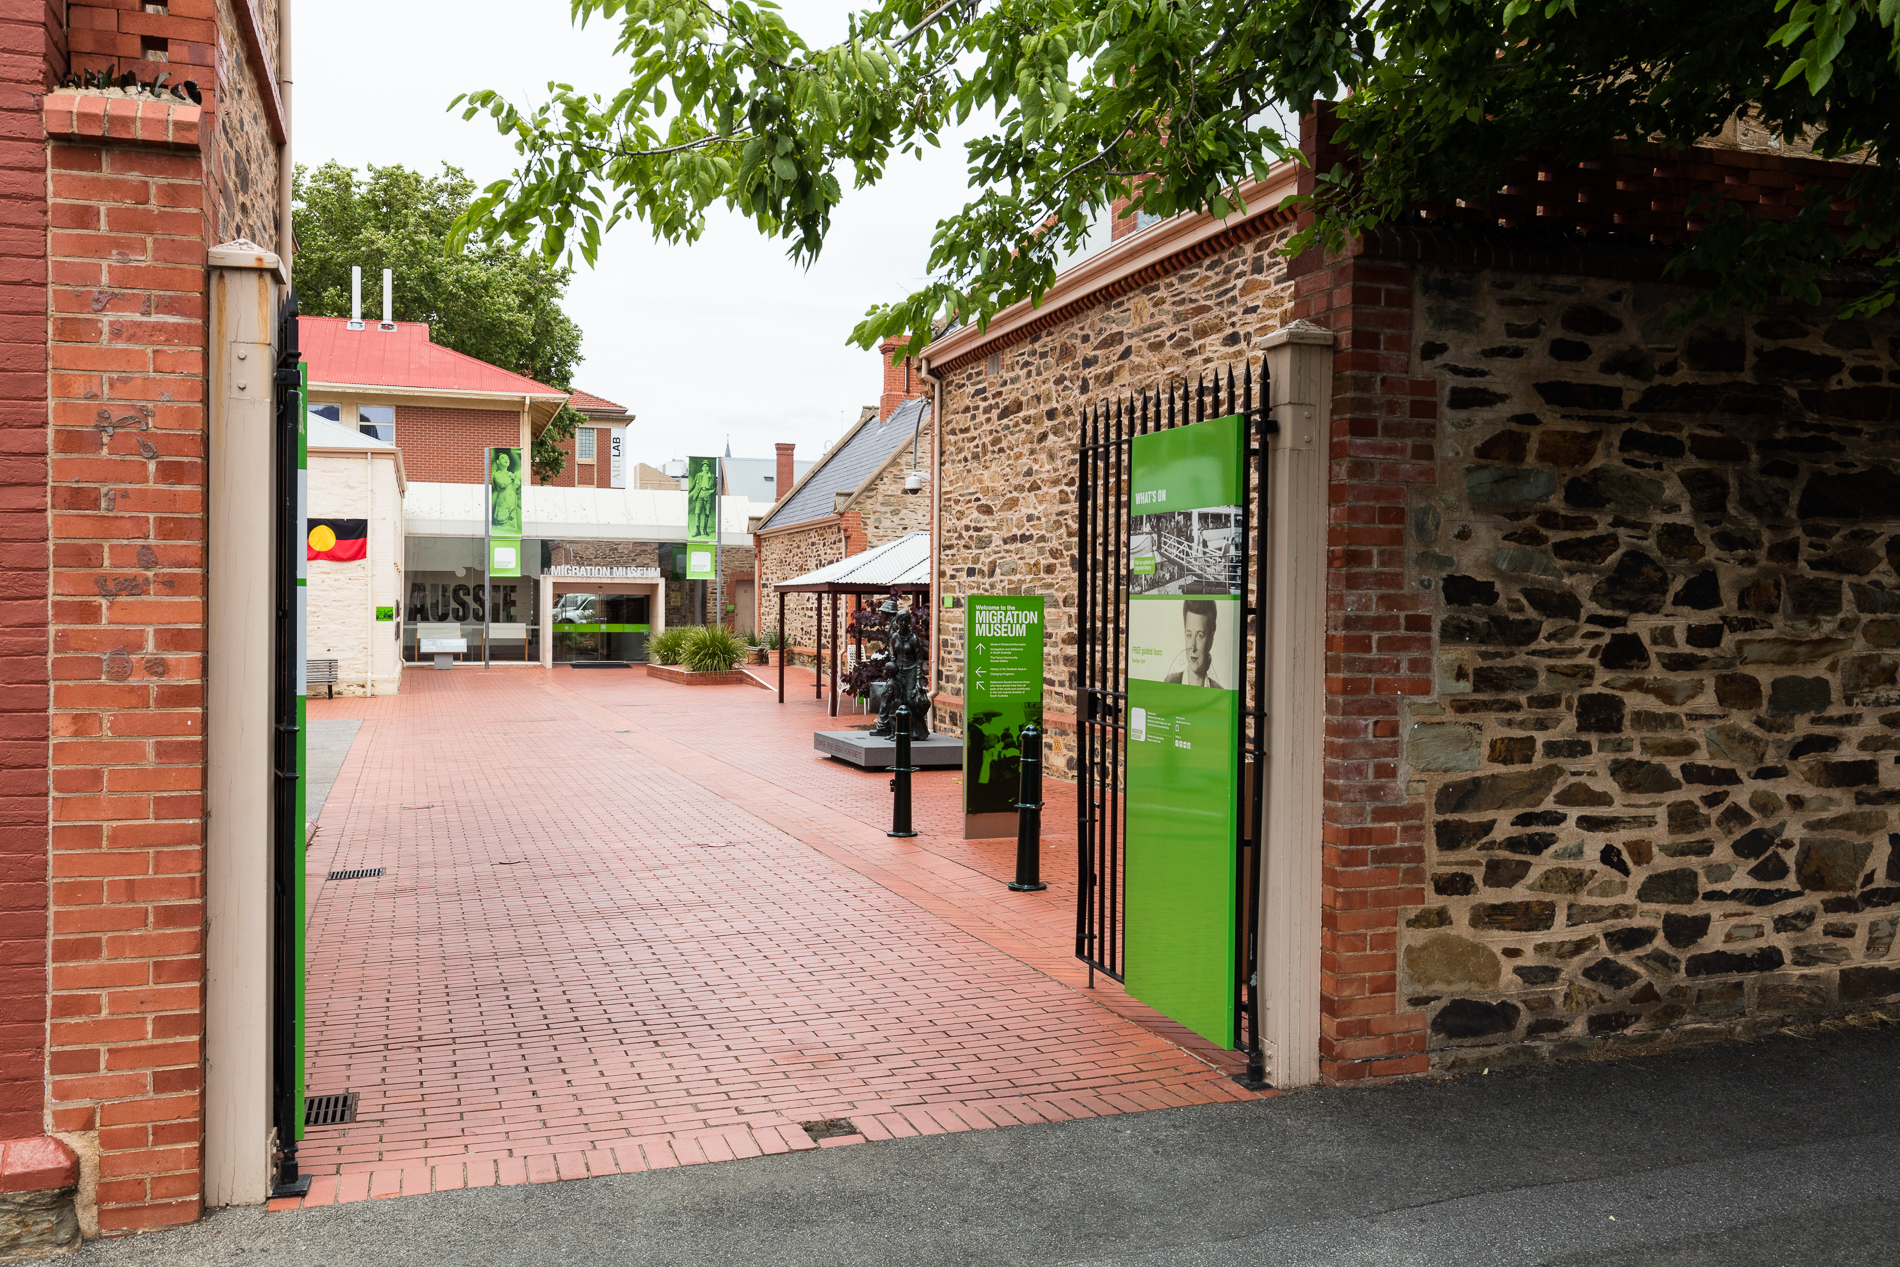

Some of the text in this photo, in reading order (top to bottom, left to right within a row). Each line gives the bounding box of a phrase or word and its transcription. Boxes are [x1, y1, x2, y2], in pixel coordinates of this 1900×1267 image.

[1135, 489, 1167, 505] WHAT'S ON
[551, 565, 661, 578] MIGRATION MUSEUM
[408, 583, 518, 623] AUSSIE
[976, 611, 1038, 624] MIGRATION
[976, 624, 1026, 637] MUSEUM
[1132, 646, 1141, 654] FREE
